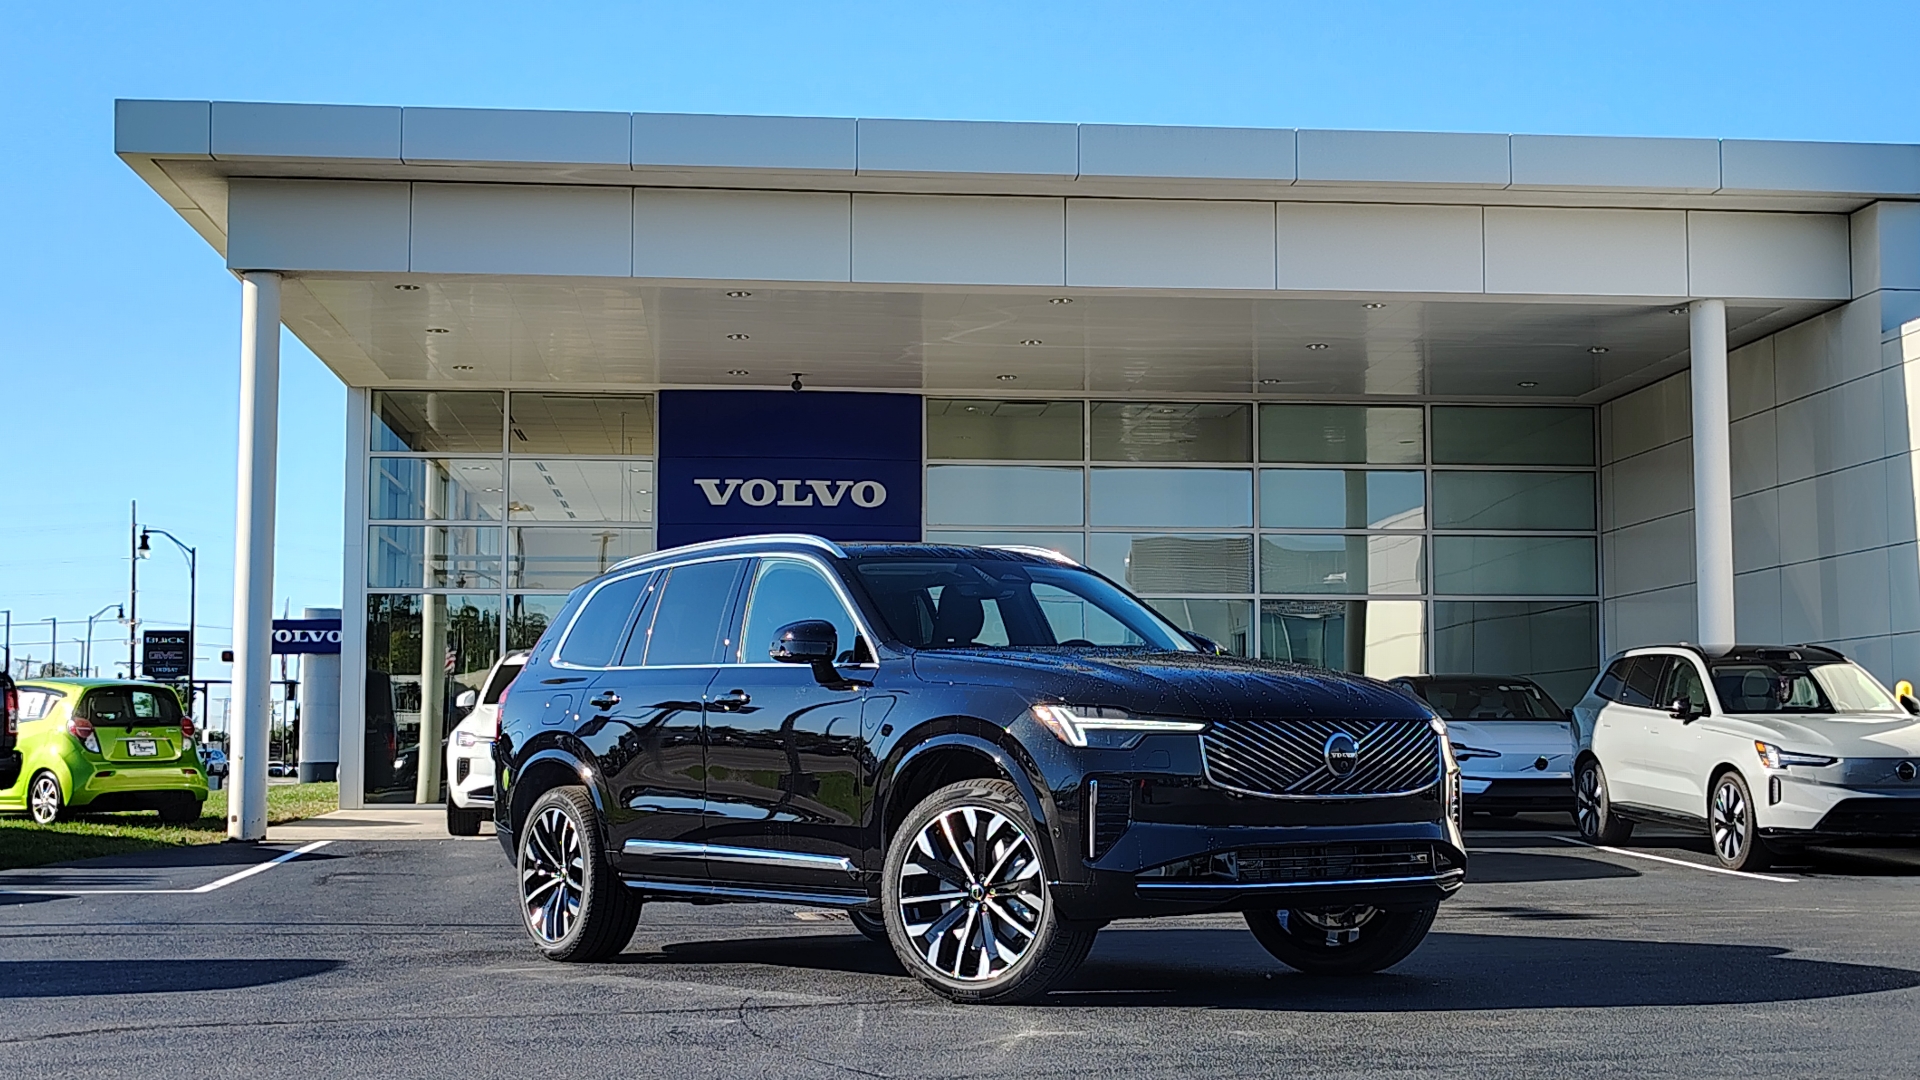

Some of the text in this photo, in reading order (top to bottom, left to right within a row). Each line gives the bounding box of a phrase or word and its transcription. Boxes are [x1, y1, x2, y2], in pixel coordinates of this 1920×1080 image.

[694, 479, 887, 508] VOLVO
[272, 630, 342, 643] OLVO
[149, 651, 183, 659] GMC
